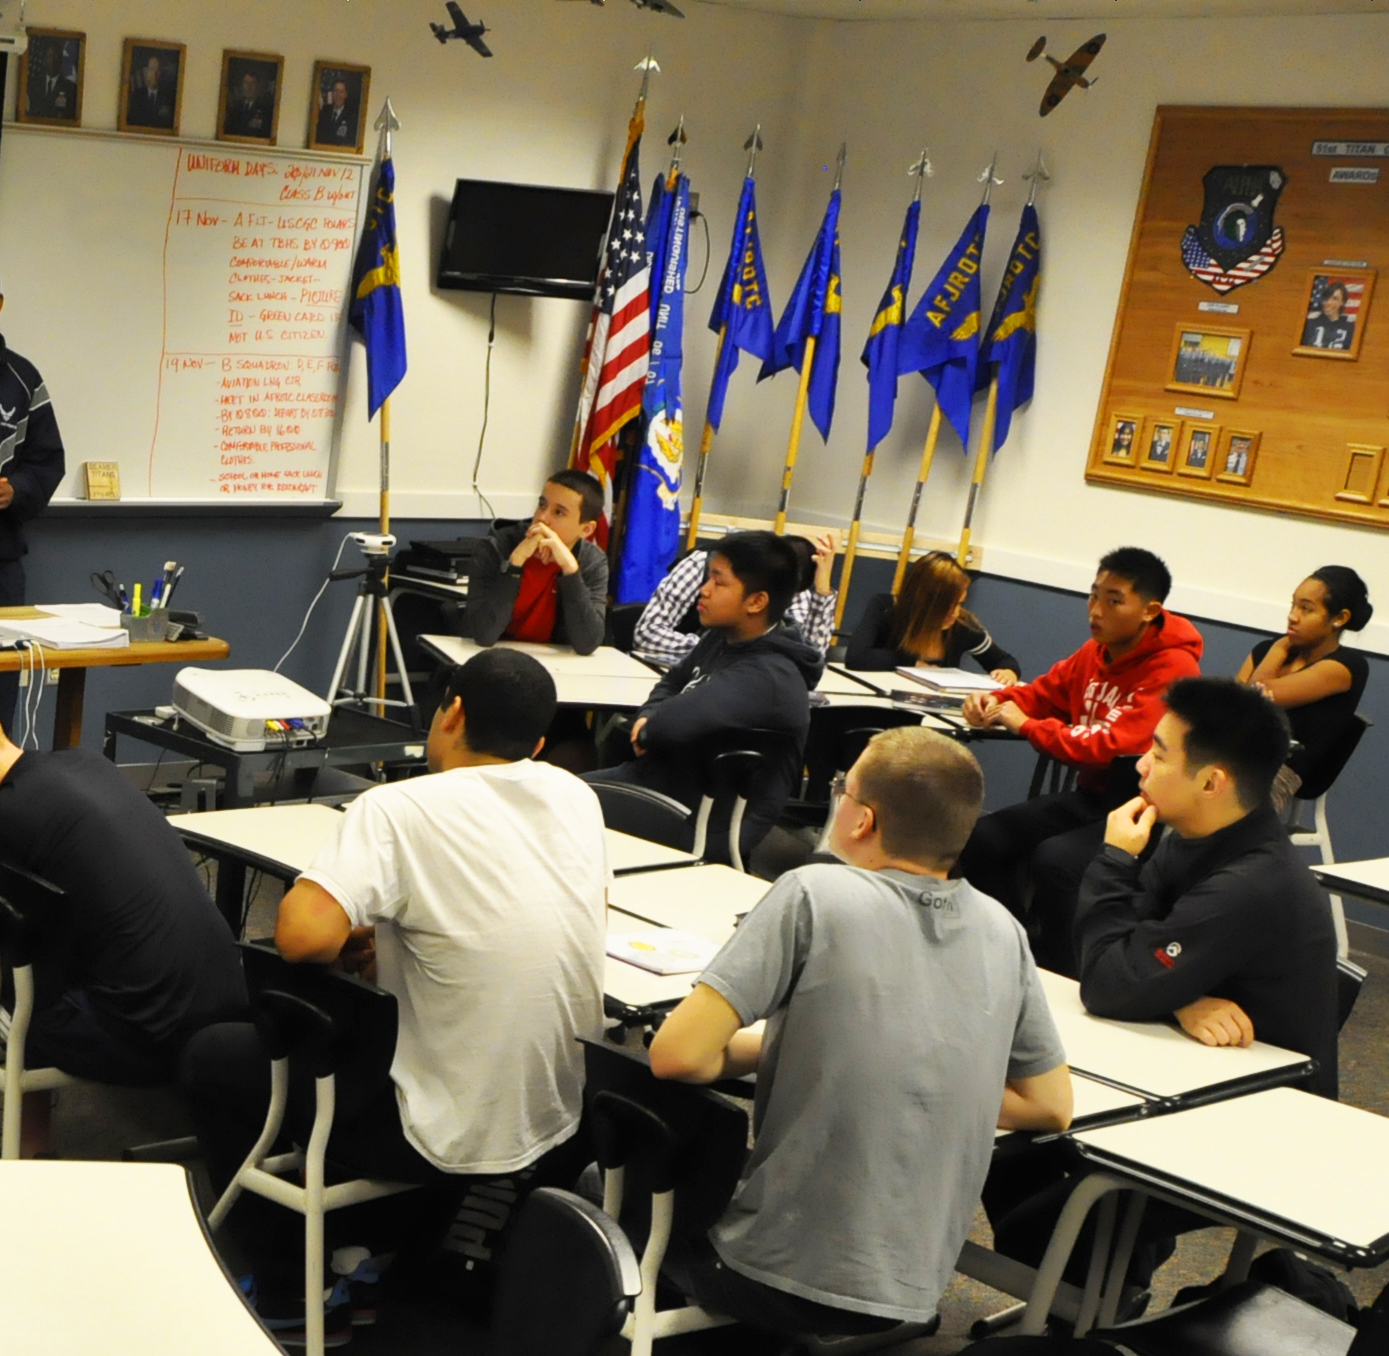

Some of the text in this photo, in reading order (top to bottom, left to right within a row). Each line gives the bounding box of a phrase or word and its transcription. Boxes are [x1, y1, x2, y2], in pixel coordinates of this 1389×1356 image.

[1346, 144, 1376, 155] TITAN
[187, 154, 240, 176] UNIFORM
[1331, 171, 1377, 182] AWARDS
[313, 185, 326, 202] B
[176, 209, 191, 226] 17
[234, 211, 243, 227] A
[232, 236, 247, 250] BE
[251, 237, 264, 248] AT
[303, 238, 317, 251] BY
[926, 233, 980, 329] AFJROT
[228, 291, 252, 302] SACK
[300, 288, 342, 303] PICTURE
[228, 309, 243, 323] ID
[259, 309, 291, 322] GREEN
[294, 310, 325, 323] CARD
[229, 332, 248, 344] NOT
[166, 358, 179, 373] 19
[222, 358, 232, 372] B
[249, 393, 259, 403] IN
[260, 425, 271, 437] BY
